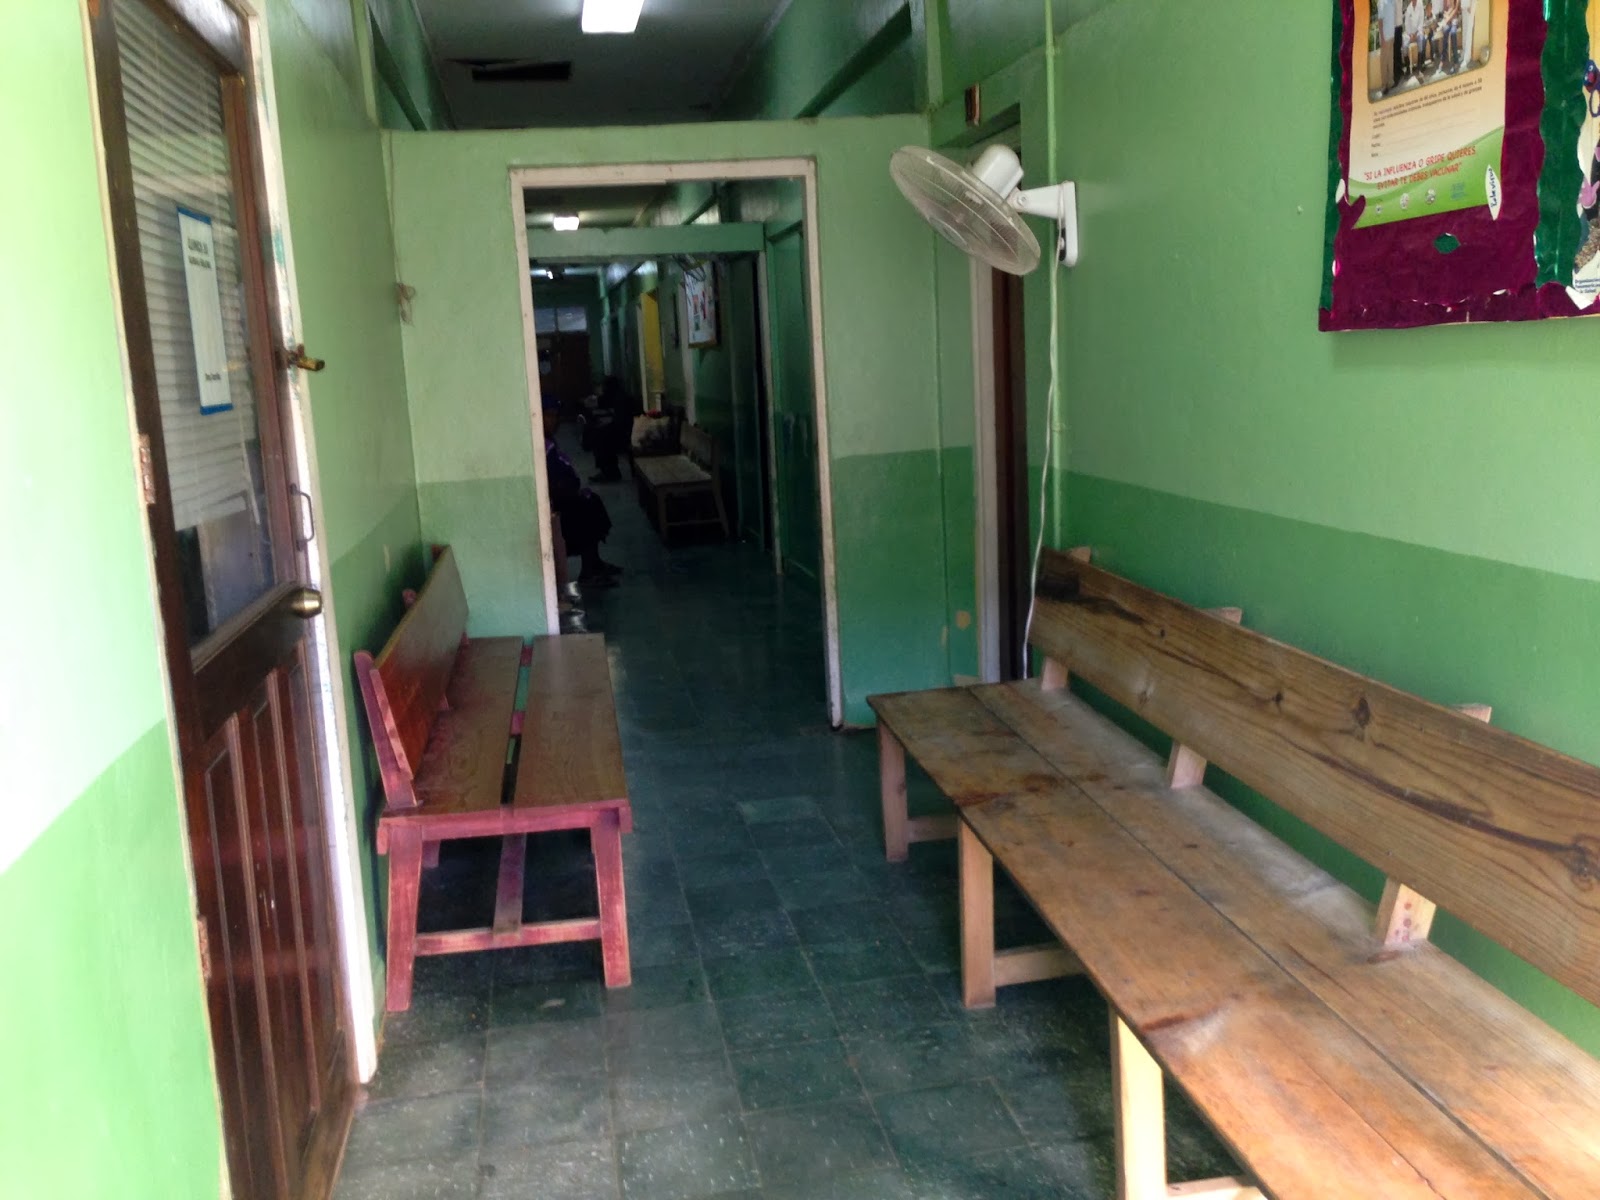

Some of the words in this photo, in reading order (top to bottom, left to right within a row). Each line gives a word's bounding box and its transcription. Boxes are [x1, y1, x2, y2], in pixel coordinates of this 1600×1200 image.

[1374, 170, 1382, 179] LA
[1383, 161, 1417, 177] INFLUENZA
[1419, 158, 1424, 168] O
[1426, 153, 1445, 166] GRIPE
[1447, 145, 1476, 161] QUIERES
[1376, 177, 1399, 190] EVITAR
[1400, 176, 1408, 185] TE
[1409, 171, 1428, 183] DEBES
